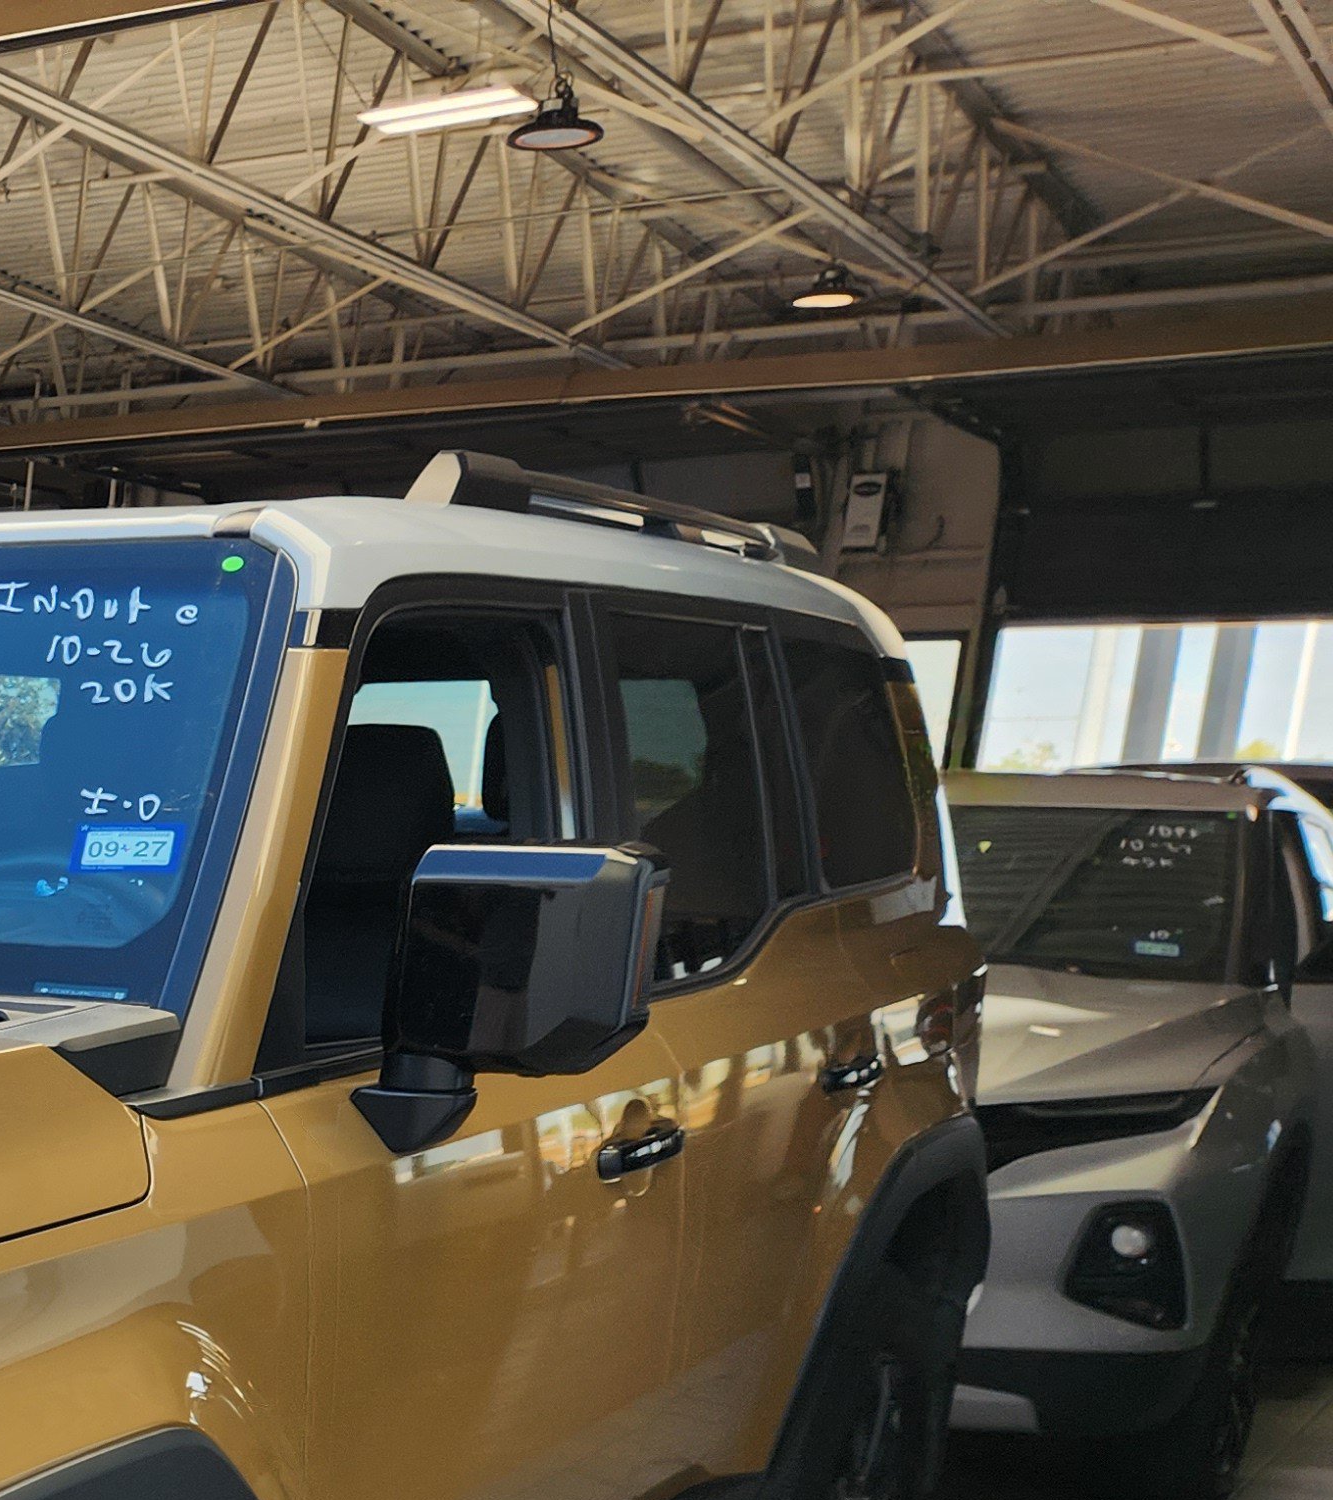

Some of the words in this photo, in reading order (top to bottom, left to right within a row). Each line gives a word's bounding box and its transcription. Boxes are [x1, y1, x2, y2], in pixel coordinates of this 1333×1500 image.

[46, 635, 172, 667] 10-26
[80, 674, 174, 704] 20K
[88, 840, 119, 858] 09
[133, 840, 168, 858] 27
